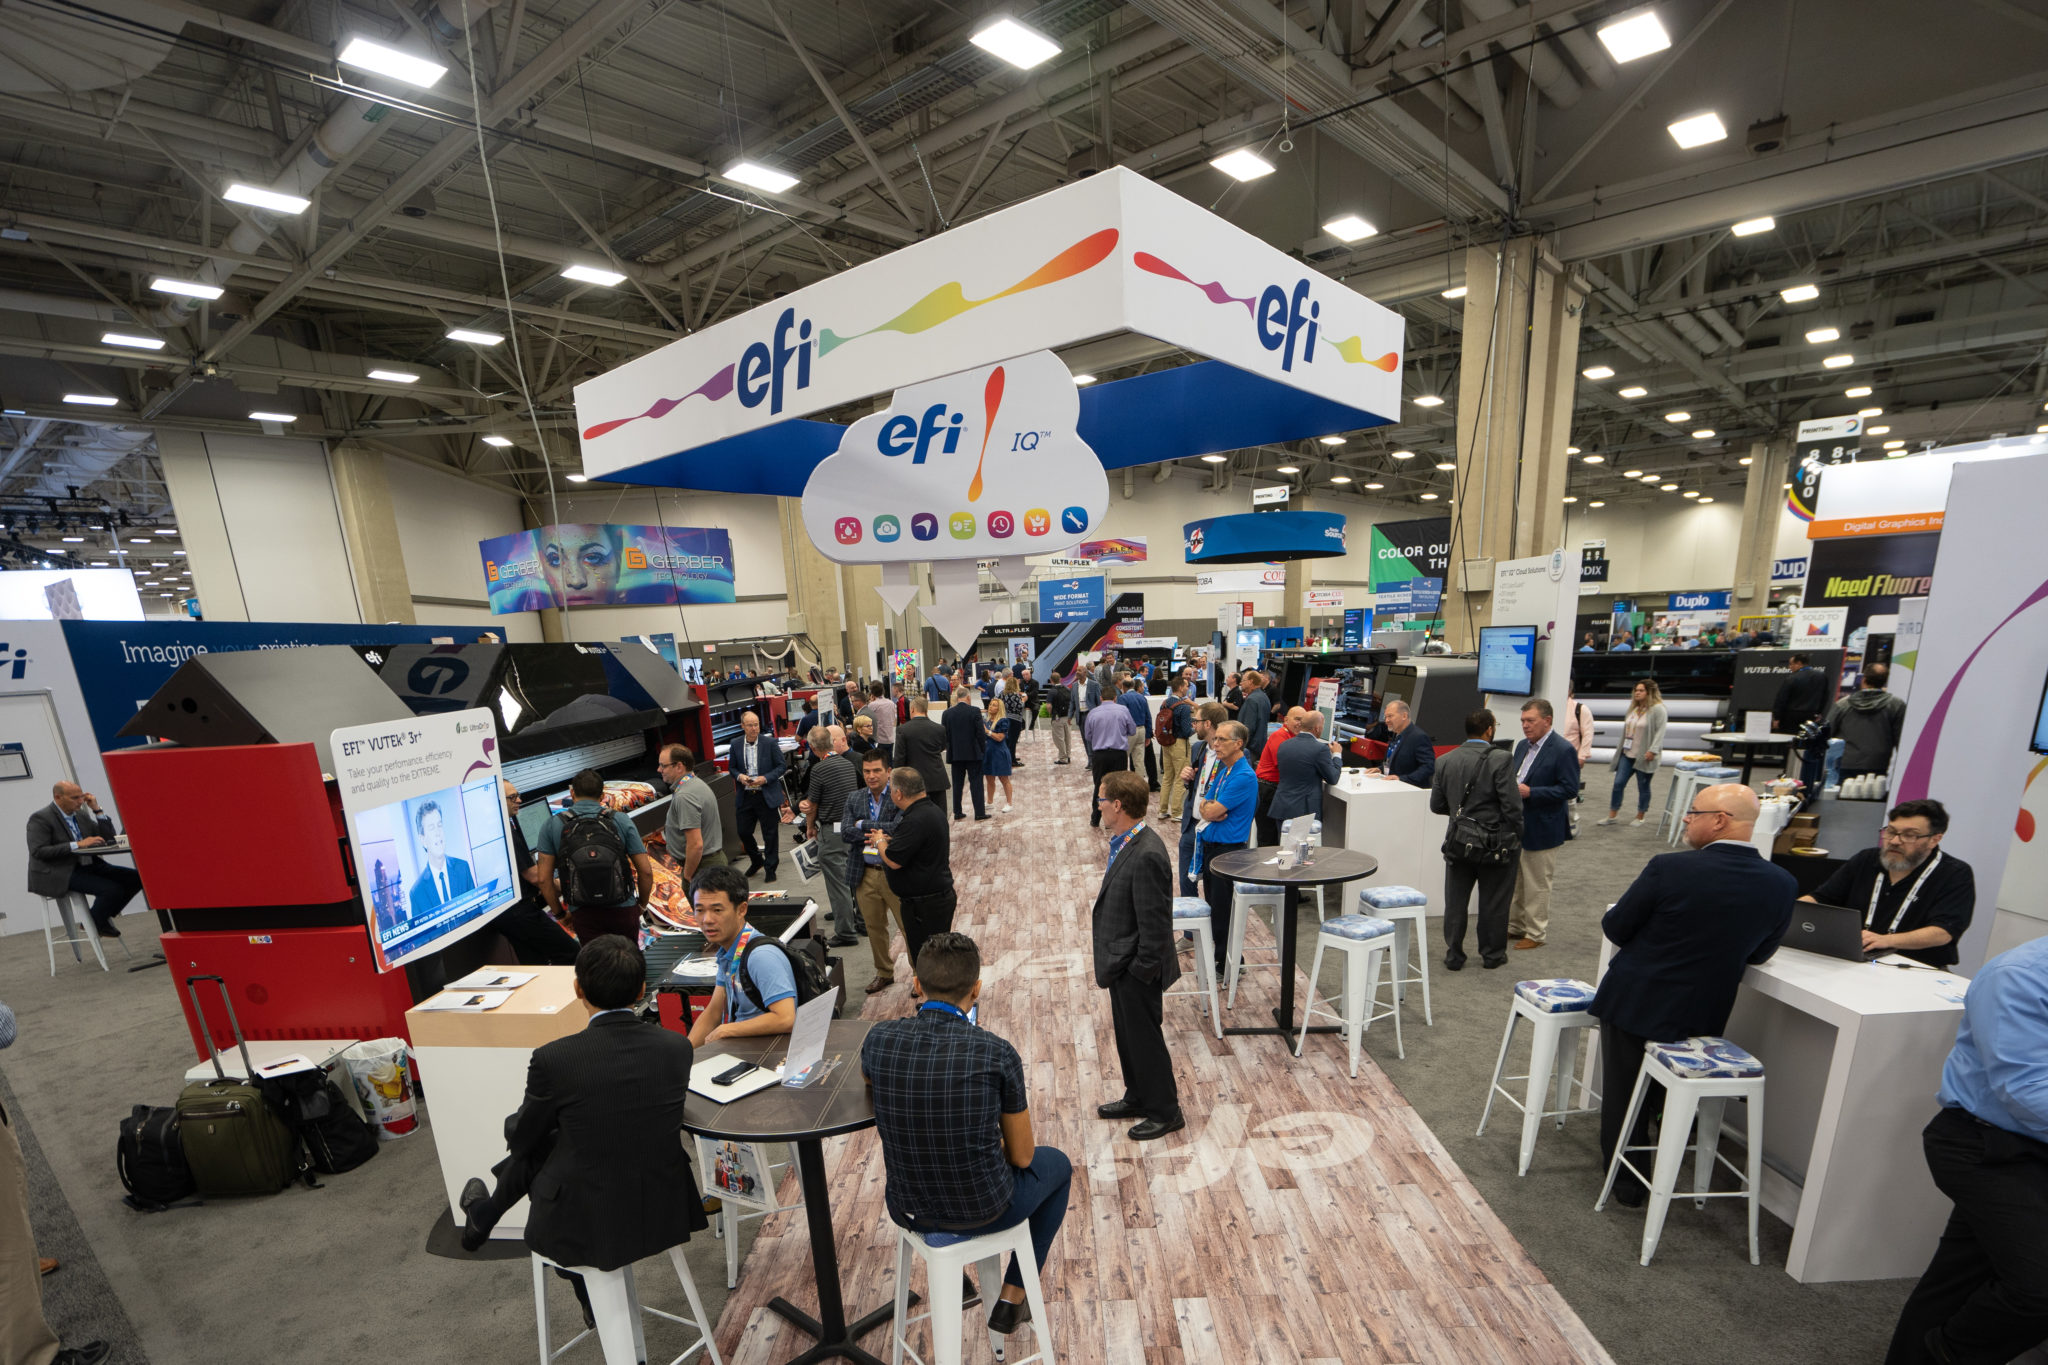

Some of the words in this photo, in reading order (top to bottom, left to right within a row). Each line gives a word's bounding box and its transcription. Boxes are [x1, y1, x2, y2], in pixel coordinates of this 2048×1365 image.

[1844, 522, 1876, 532] Digital
[1878, 517, 1926, 530] Graphics
[1378, 545, 1424, 560] COLOR
[1428, 543, 1451, 556] OU
[500, 560, 540, 578] GERBER
[651, 554, 724, 569] GERBER
[1824, 575, 1874, 598] Need
[1675, 595, 1710, 609] Duplo
[120, 640, 208, 668] Imagine
[347, 768, 366, 779] Take
[367, 764, 384, 776] your
[351, 783, 366, 794] and
[367, 776, 391, 792] quality
[391, 774, 400, 784] to
[399, 771, 411, 783] the
[411, 765, 440, 779] EXTREME
[382, 930, 393, 942] EFI
[393, 923, 410, 937] NEWS
